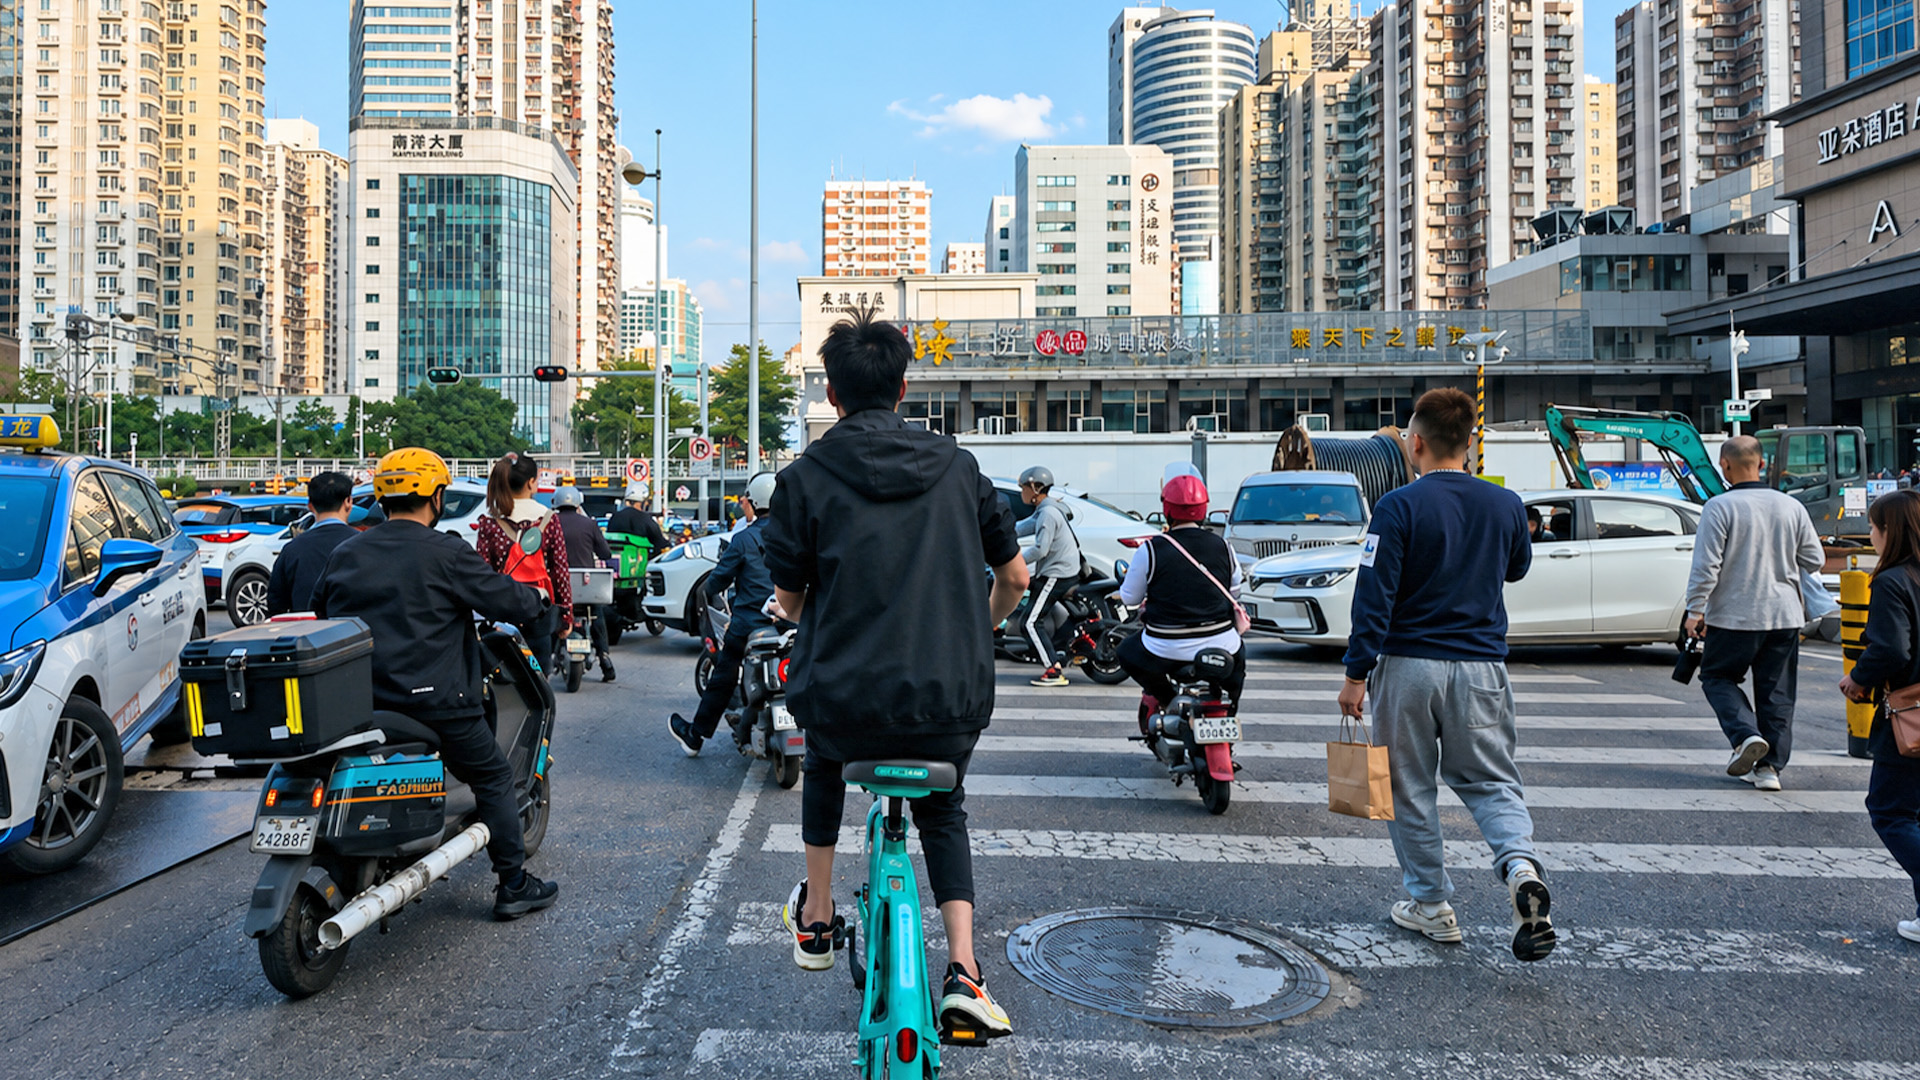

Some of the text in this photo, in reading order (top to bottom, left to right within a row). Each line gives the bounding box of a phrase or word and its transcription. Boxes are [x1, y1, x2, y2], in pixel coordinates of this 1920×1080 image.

[1817, 103, 1904, 164] 亚朵酒店
[0, 417, 32, 436] 龙
[256, 832, 311, 847] 24288F
